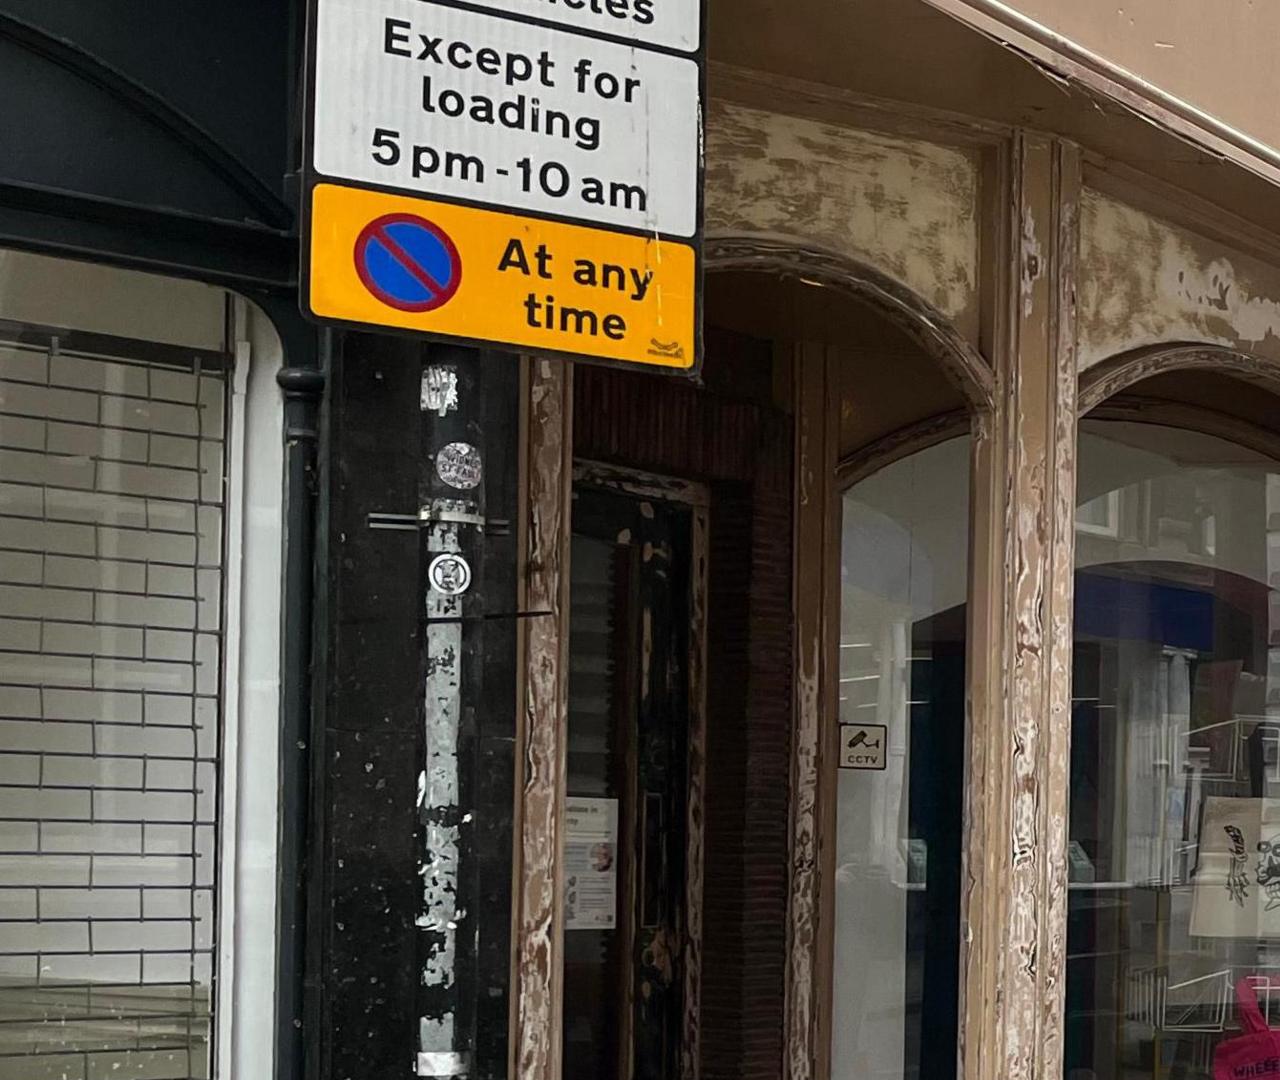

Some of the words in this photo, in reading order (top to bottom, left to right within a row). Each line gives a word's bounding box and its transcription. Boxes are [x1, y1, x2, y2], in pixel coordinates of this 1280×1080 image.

[384, 18, 555, 87] Except
[575, 59, 641, 103] for
[422, 76, 600, 151] loading
[497, 238, 553, 279] At
[573, 259, 654, 301] any
[523, 293, 627, 340] time
[847, 755, 878, 764] CCTV
